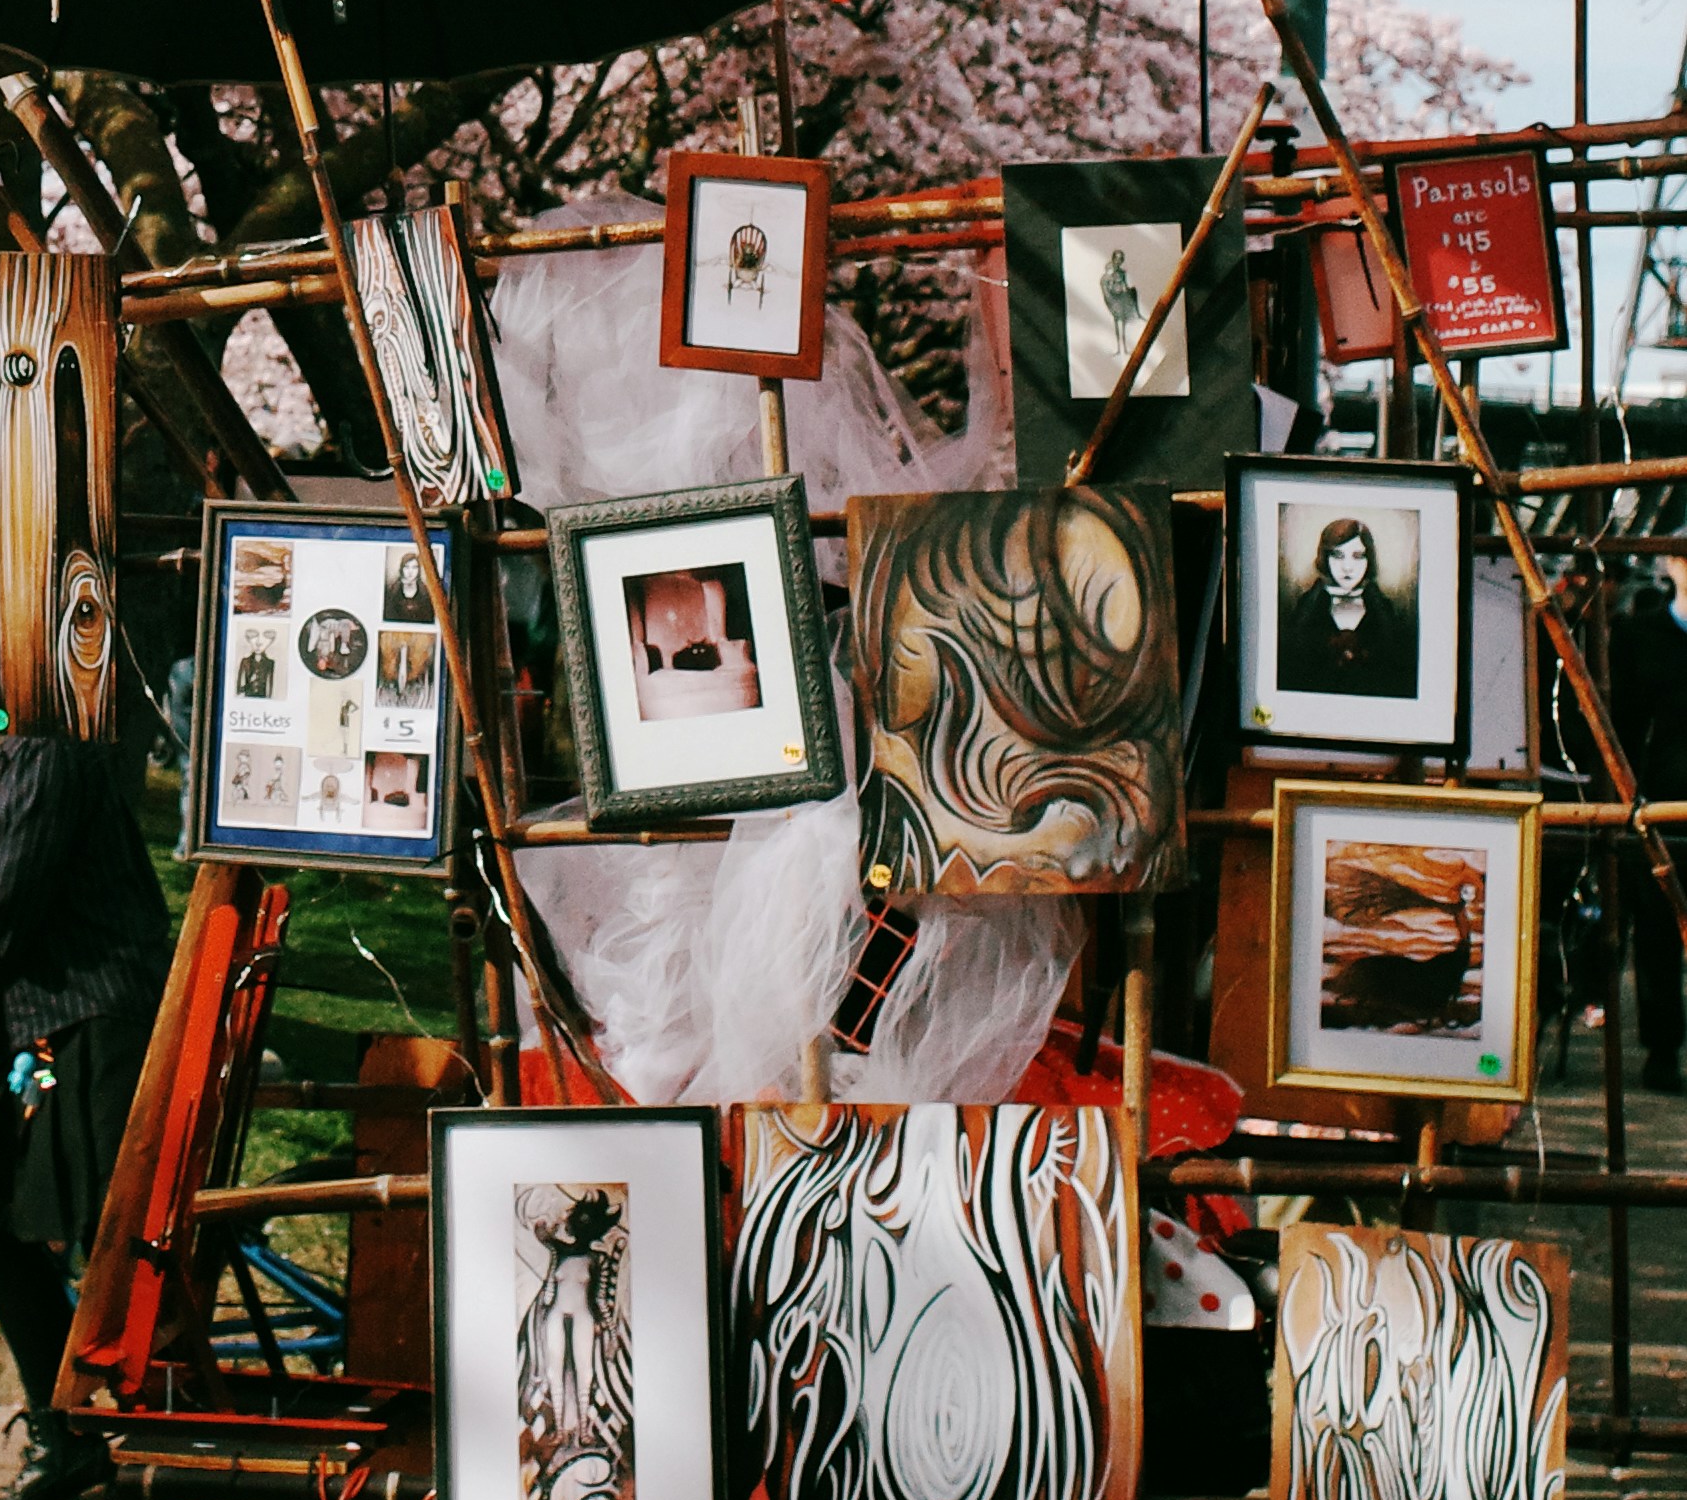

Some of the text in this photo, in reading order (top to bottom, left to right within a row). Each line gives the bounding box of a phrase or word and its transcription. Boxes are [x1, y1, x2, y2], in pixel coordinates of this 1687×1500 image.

[1412, 166, 1530, 207] Parasols
[1453, 210, 1488, 225] are
[229, 711, 291, 727] Stickers
